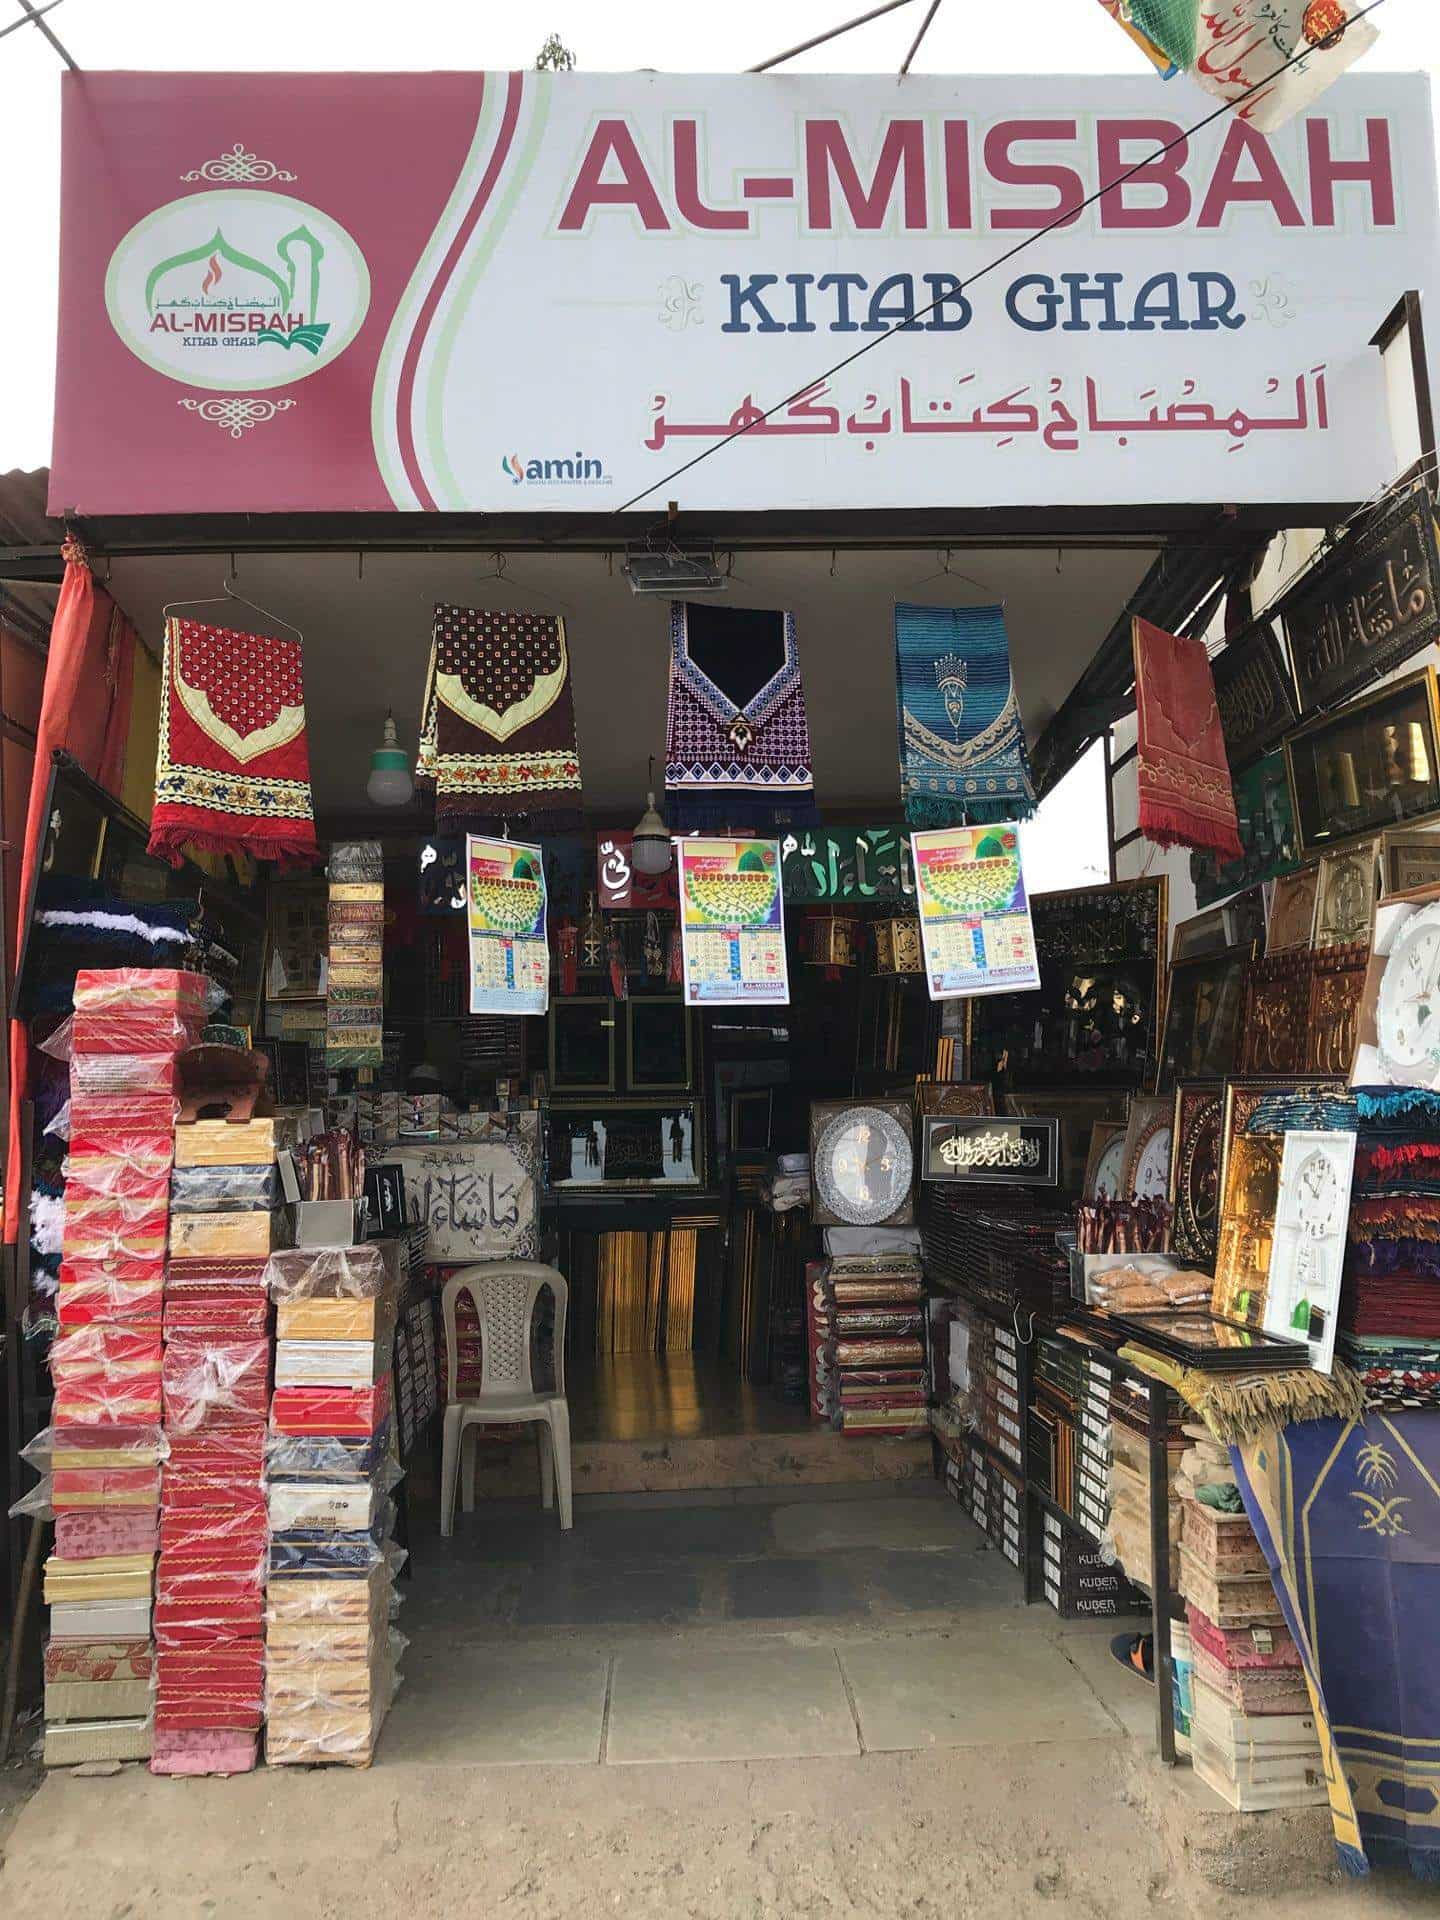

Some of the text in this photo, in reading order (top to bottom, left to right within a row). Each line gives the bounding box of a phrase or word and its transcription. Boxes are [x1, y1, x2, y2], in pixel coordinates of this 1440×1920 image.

[560, 118, 1394, 230] AL-MISBAH
[721, 272, 1246, 333] KITAB GHAR
[150, 313, 304, 332] AL-MISBAH
[182, 337, 218, 346] KITAB
[1077, 1600, 1115, 1611] KUBER
